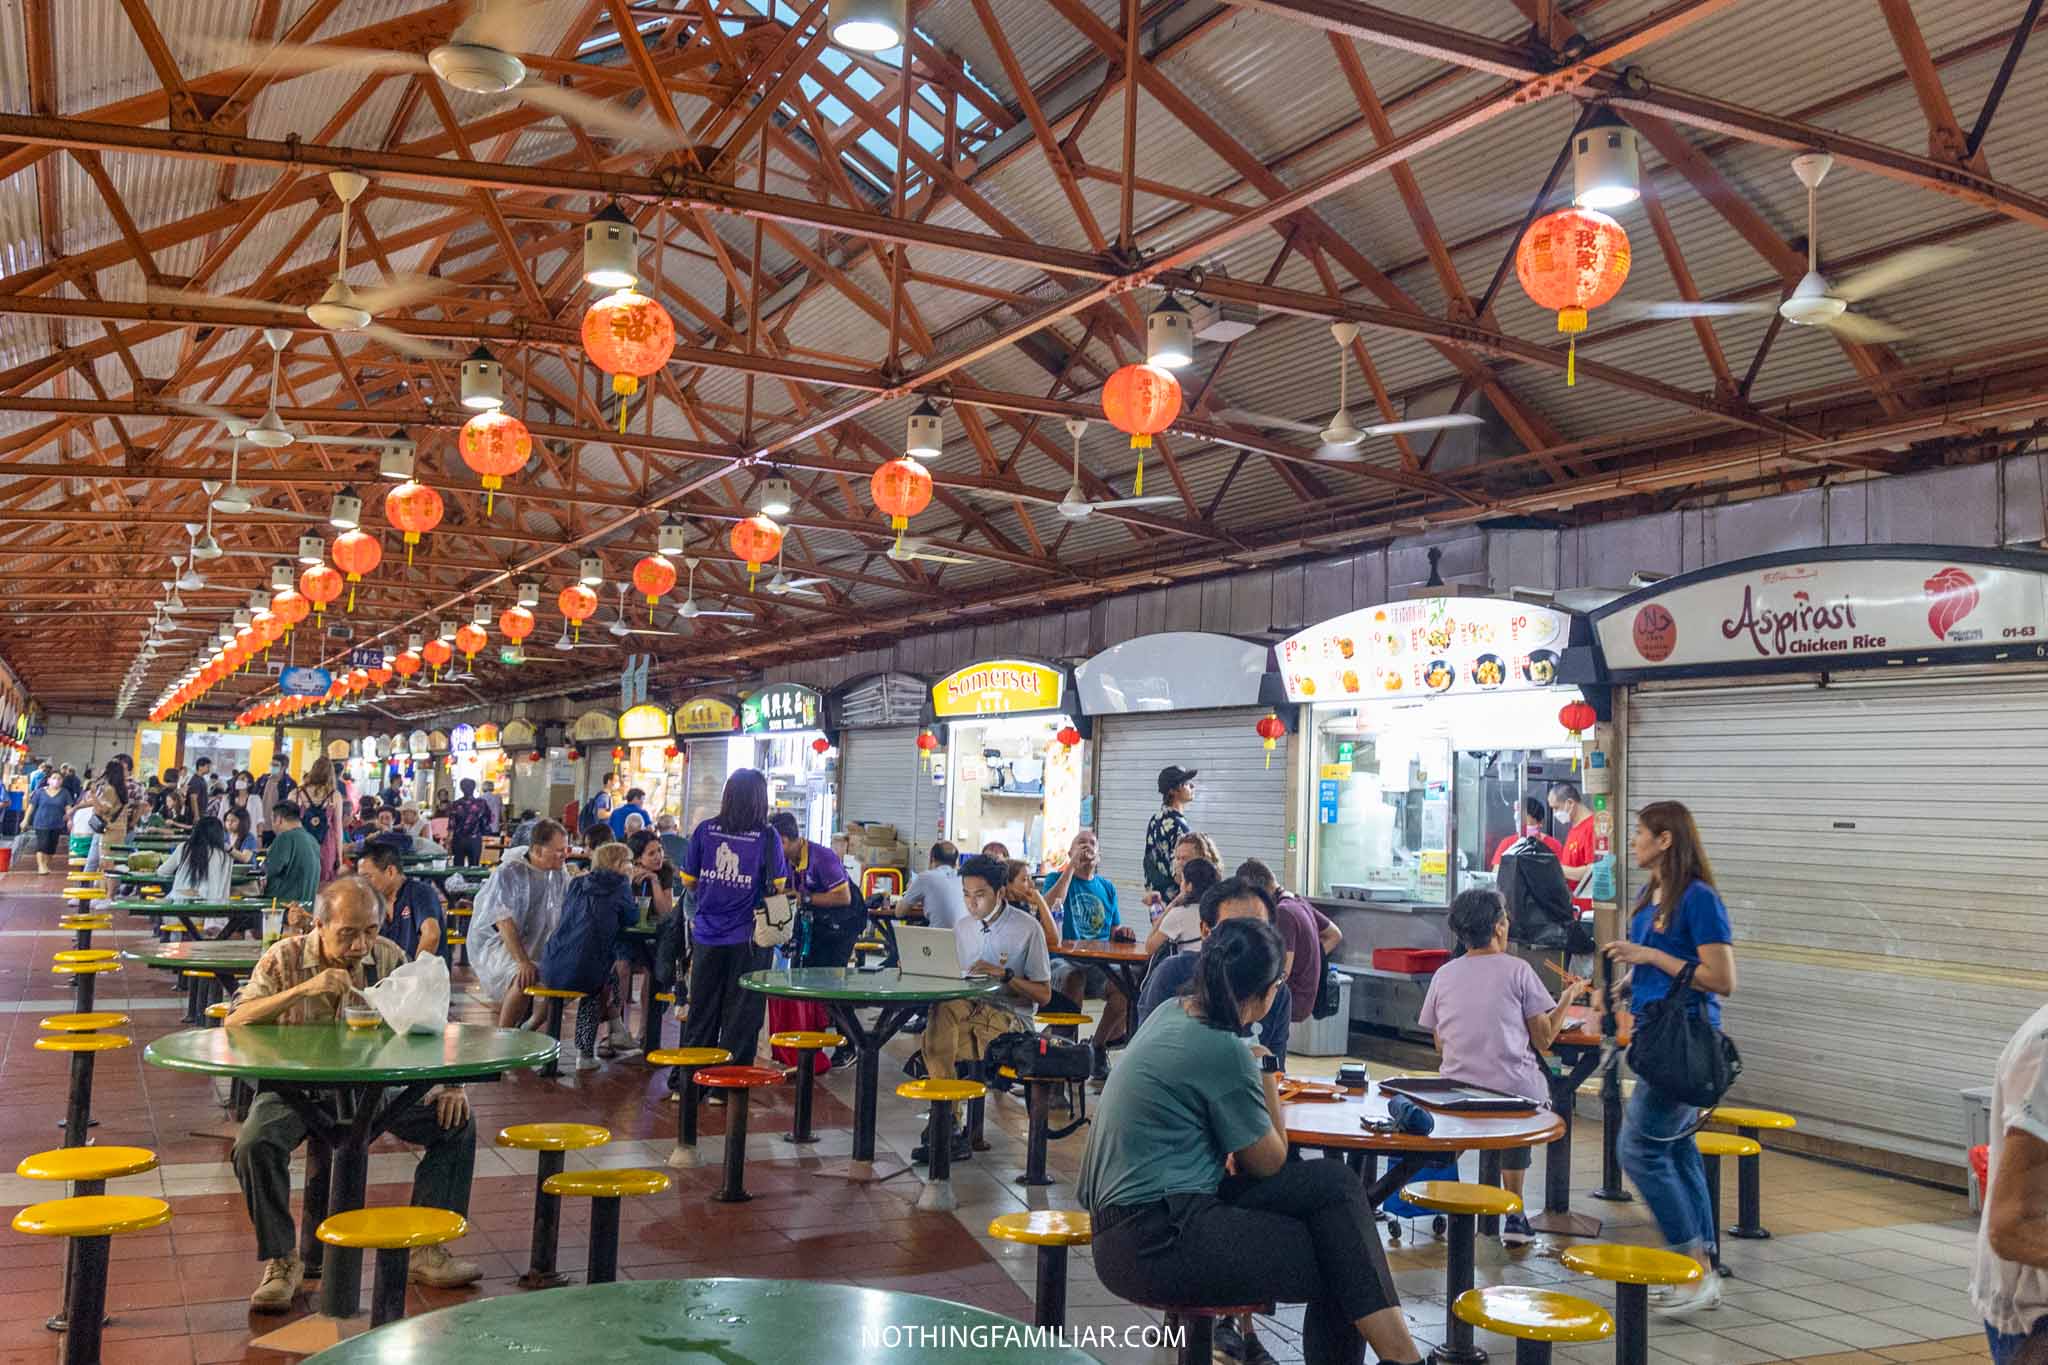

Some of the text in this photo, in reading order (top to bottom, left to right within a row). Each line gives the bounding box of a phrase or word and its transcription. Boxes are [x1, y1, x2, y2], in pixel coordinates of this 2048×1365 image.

[1722, 585, 1856, 655] Aspirasi
[2002, 626, 2036, 638] 01-63
[1789, 635, 1886, 653] Chicken Rice
[948, 670, 1039, 704] Somerset
[700, 867, 752, 884] MONSTER
